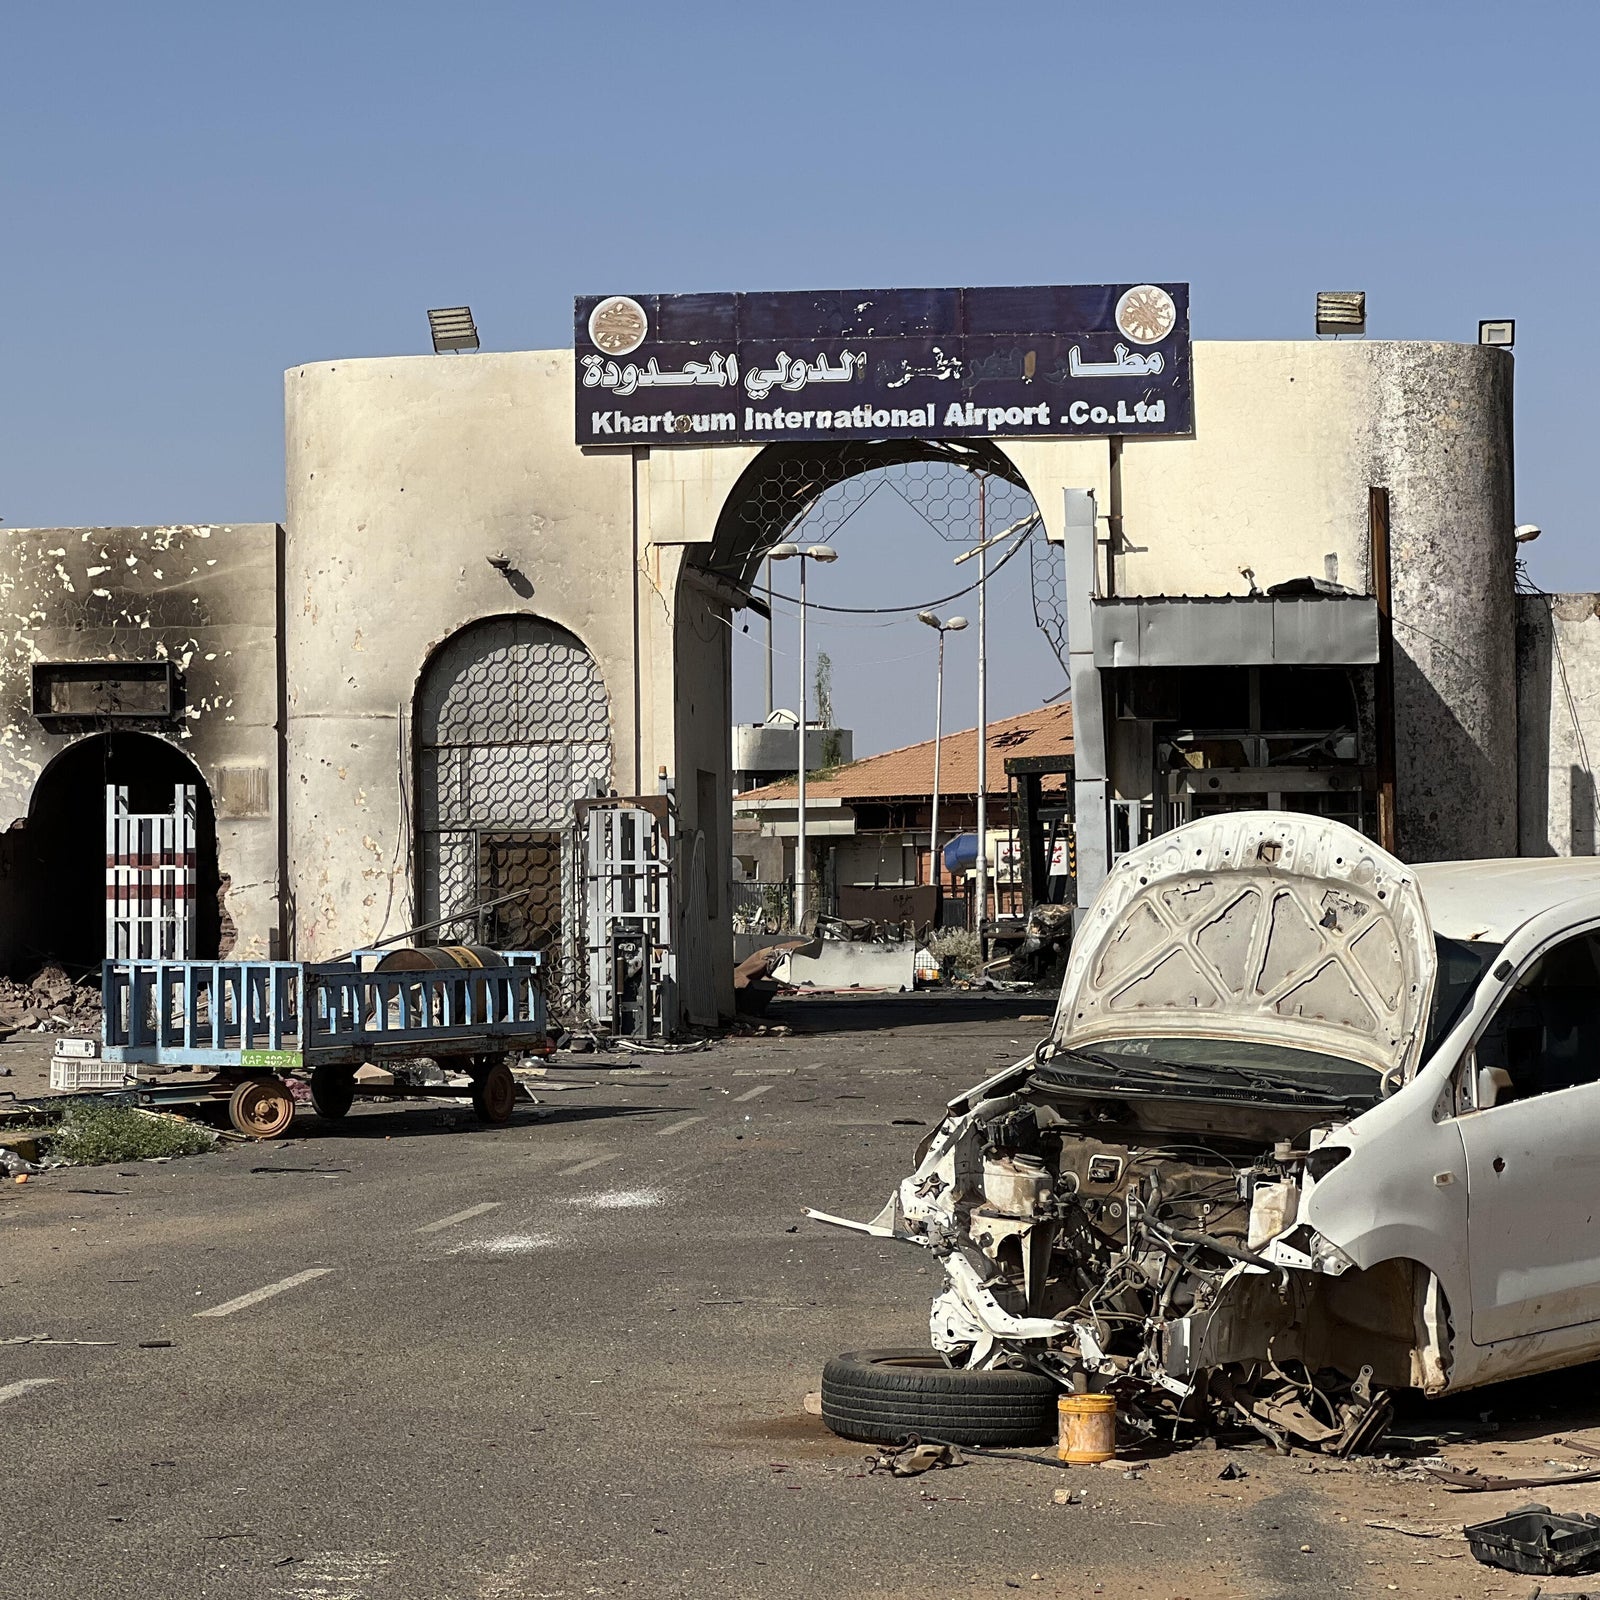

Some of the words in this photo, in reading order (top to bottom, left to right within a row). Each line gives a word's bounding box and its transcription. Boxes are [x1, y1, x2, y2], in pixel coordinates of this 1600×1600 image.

[581, 350, 739, 394] المحدودة
[744, 404, 935, 431] International
[943, 401, 1050, 430] Airport
[1060, 399, 1165, 425] .Co.Ltd
